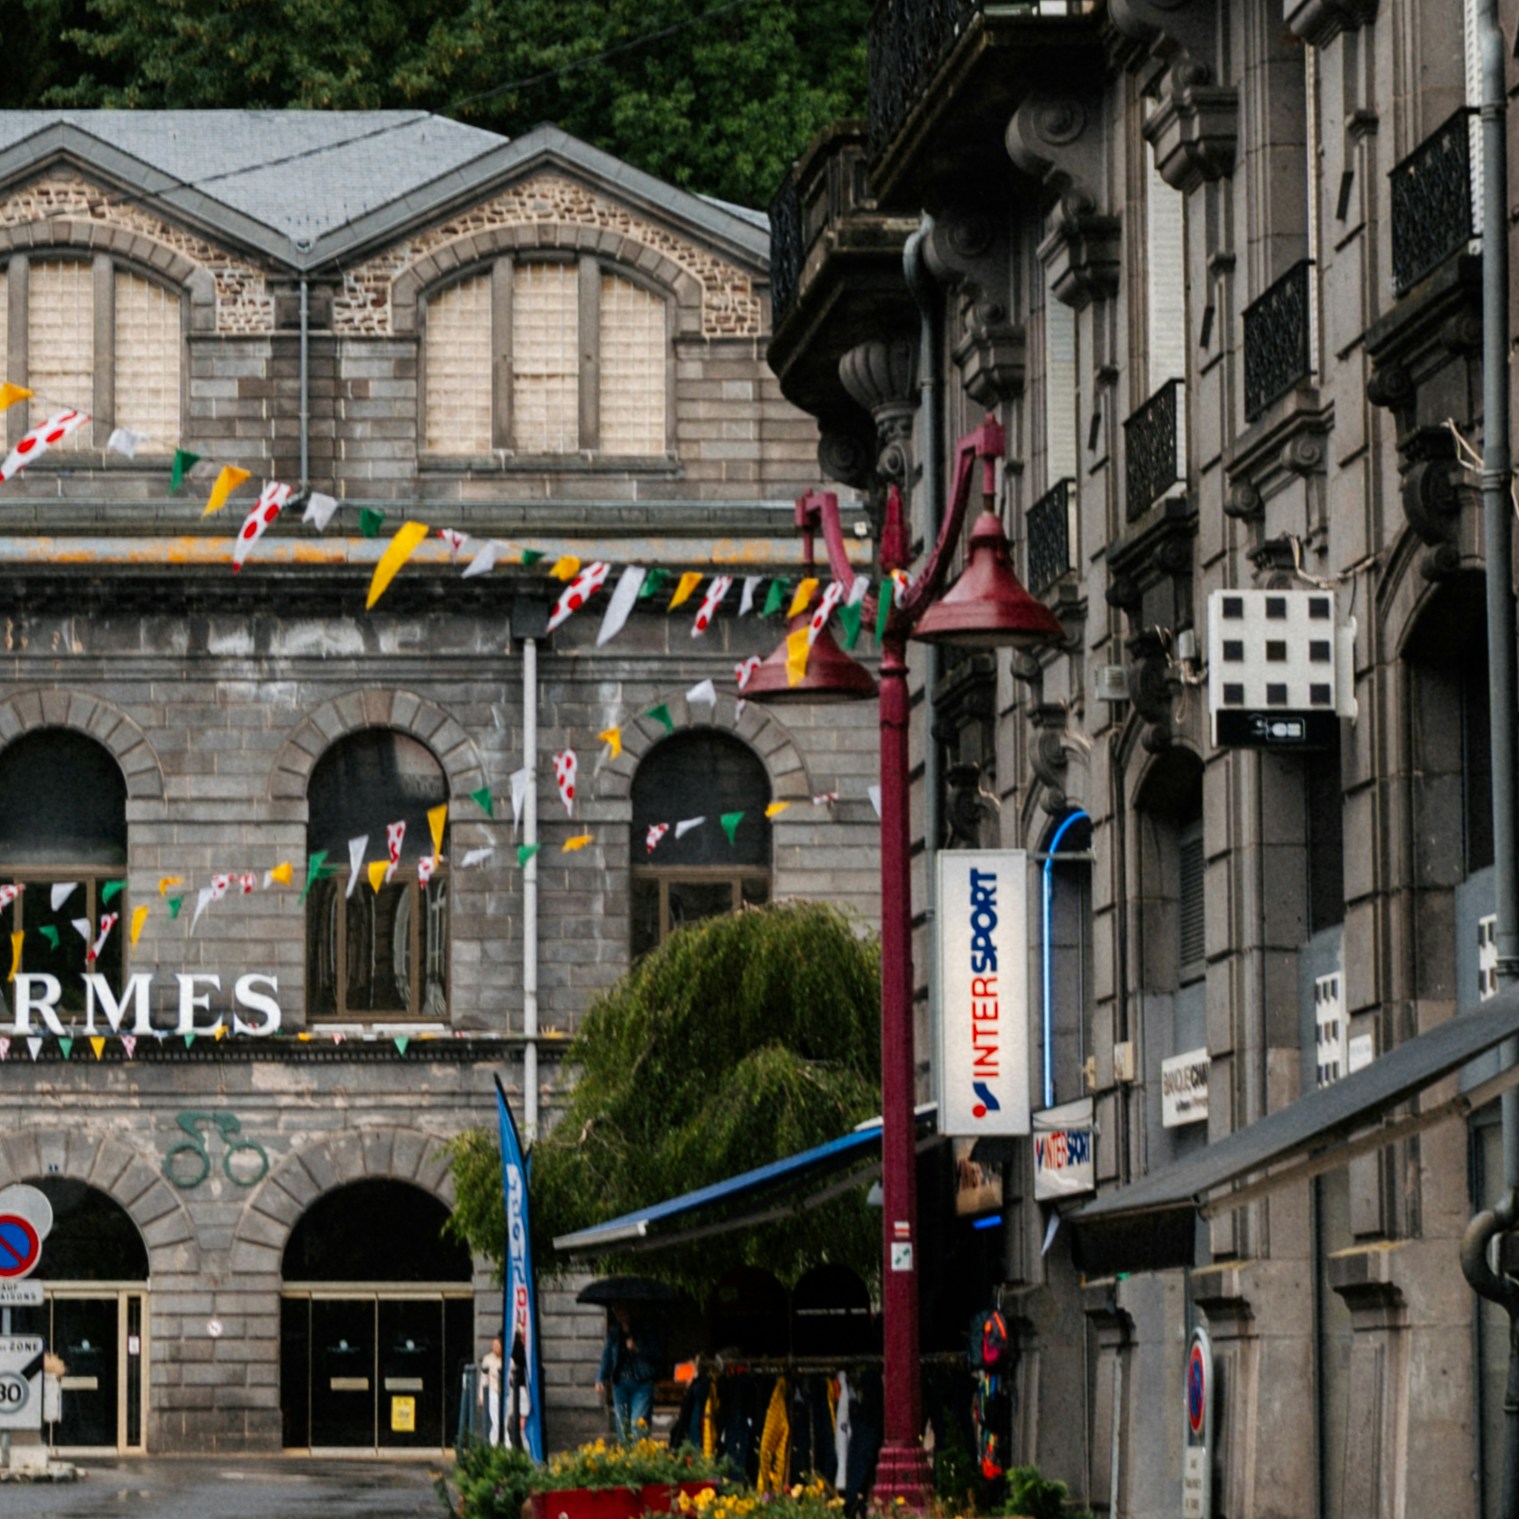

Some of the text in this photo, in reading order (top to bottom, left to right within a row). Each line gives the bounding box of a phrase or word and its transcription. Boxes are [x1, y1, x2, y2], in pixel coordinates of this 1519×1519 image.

[970, 867, 998, 1078] INTERSPORT
[1044, 1130, 1091, 1170] INTERSPORT
[9, 1340, 38, 1352] ZONE
